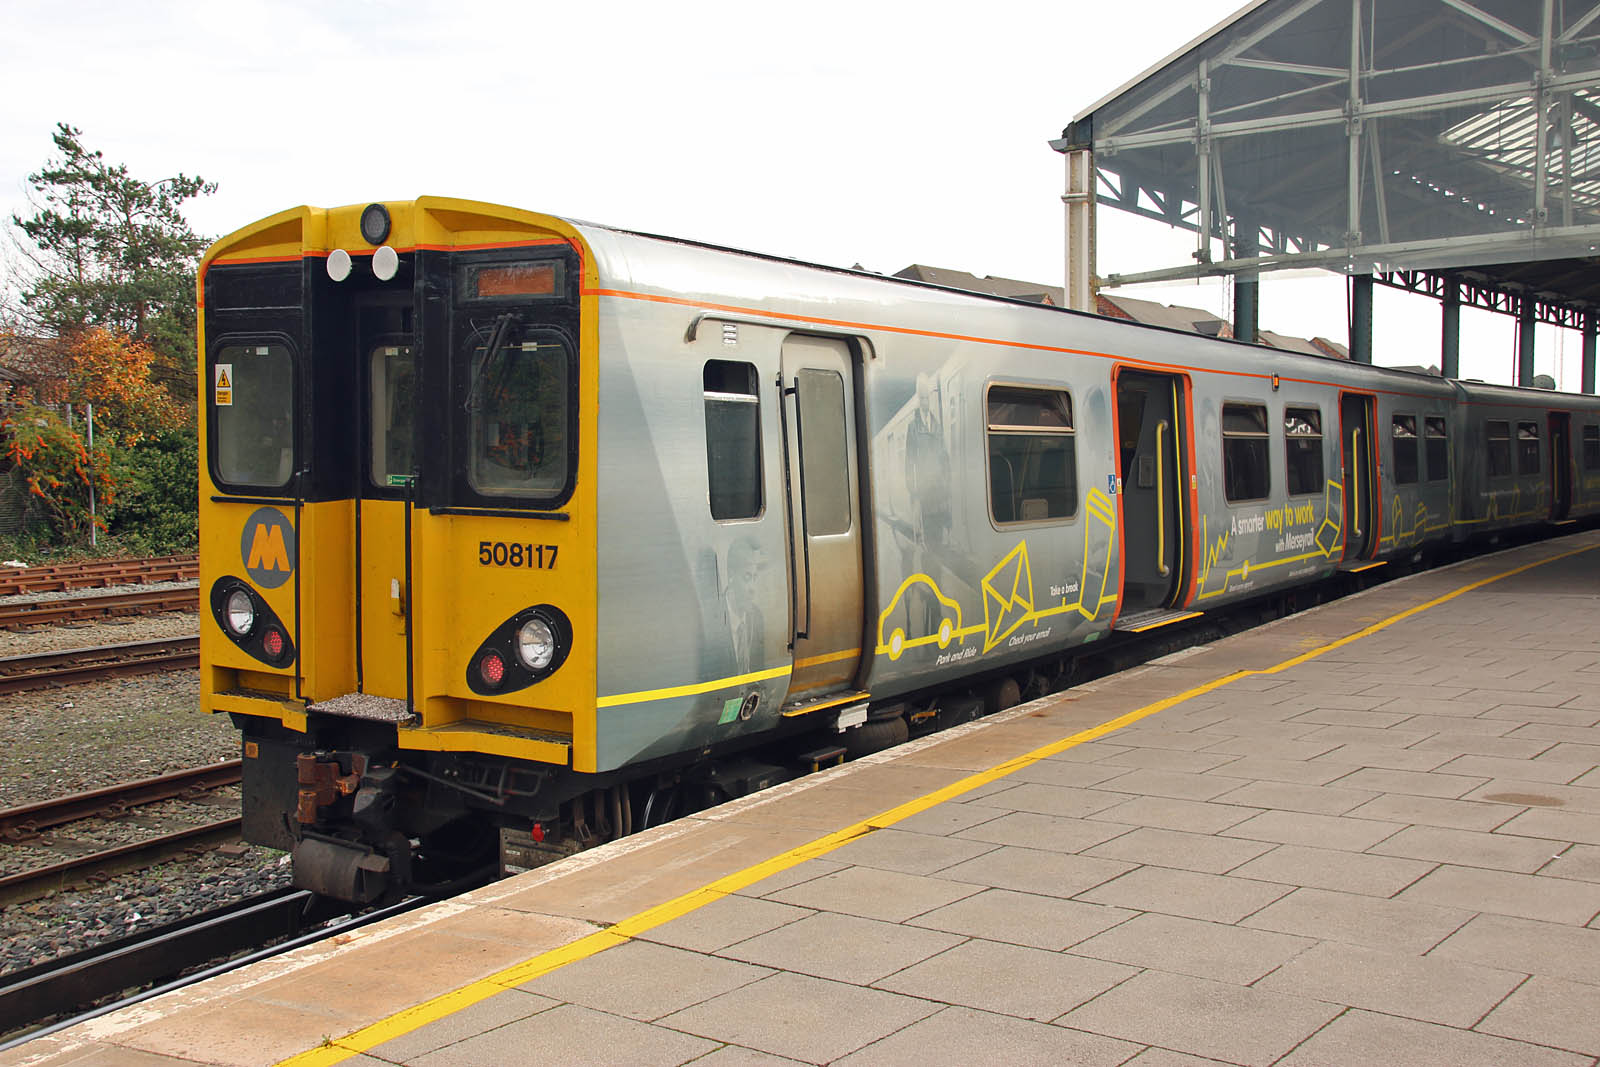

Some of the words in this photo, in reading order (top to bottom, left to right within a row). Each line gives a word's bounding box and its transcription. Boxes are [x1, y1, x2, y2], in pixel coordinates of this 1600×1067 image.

[1231, 515, 1237, 536] A
[1238, 513, 1264, 535] smarter
[1265, 508, 1283, 536] way
[1284, 503, 1293, 527] to
[1294, 499, 1314, 526] work
[1275, 538, 1285, 553] with
[1285, 527, 1315, 553] Merseyrail
[479, 541, 558, 569] 508117
[1050, 584, 1061, 596] Take
[1065, 581, 1079, 593] break
[935, 652, 951, 666] Park
[951, 648, 965, 662] and
